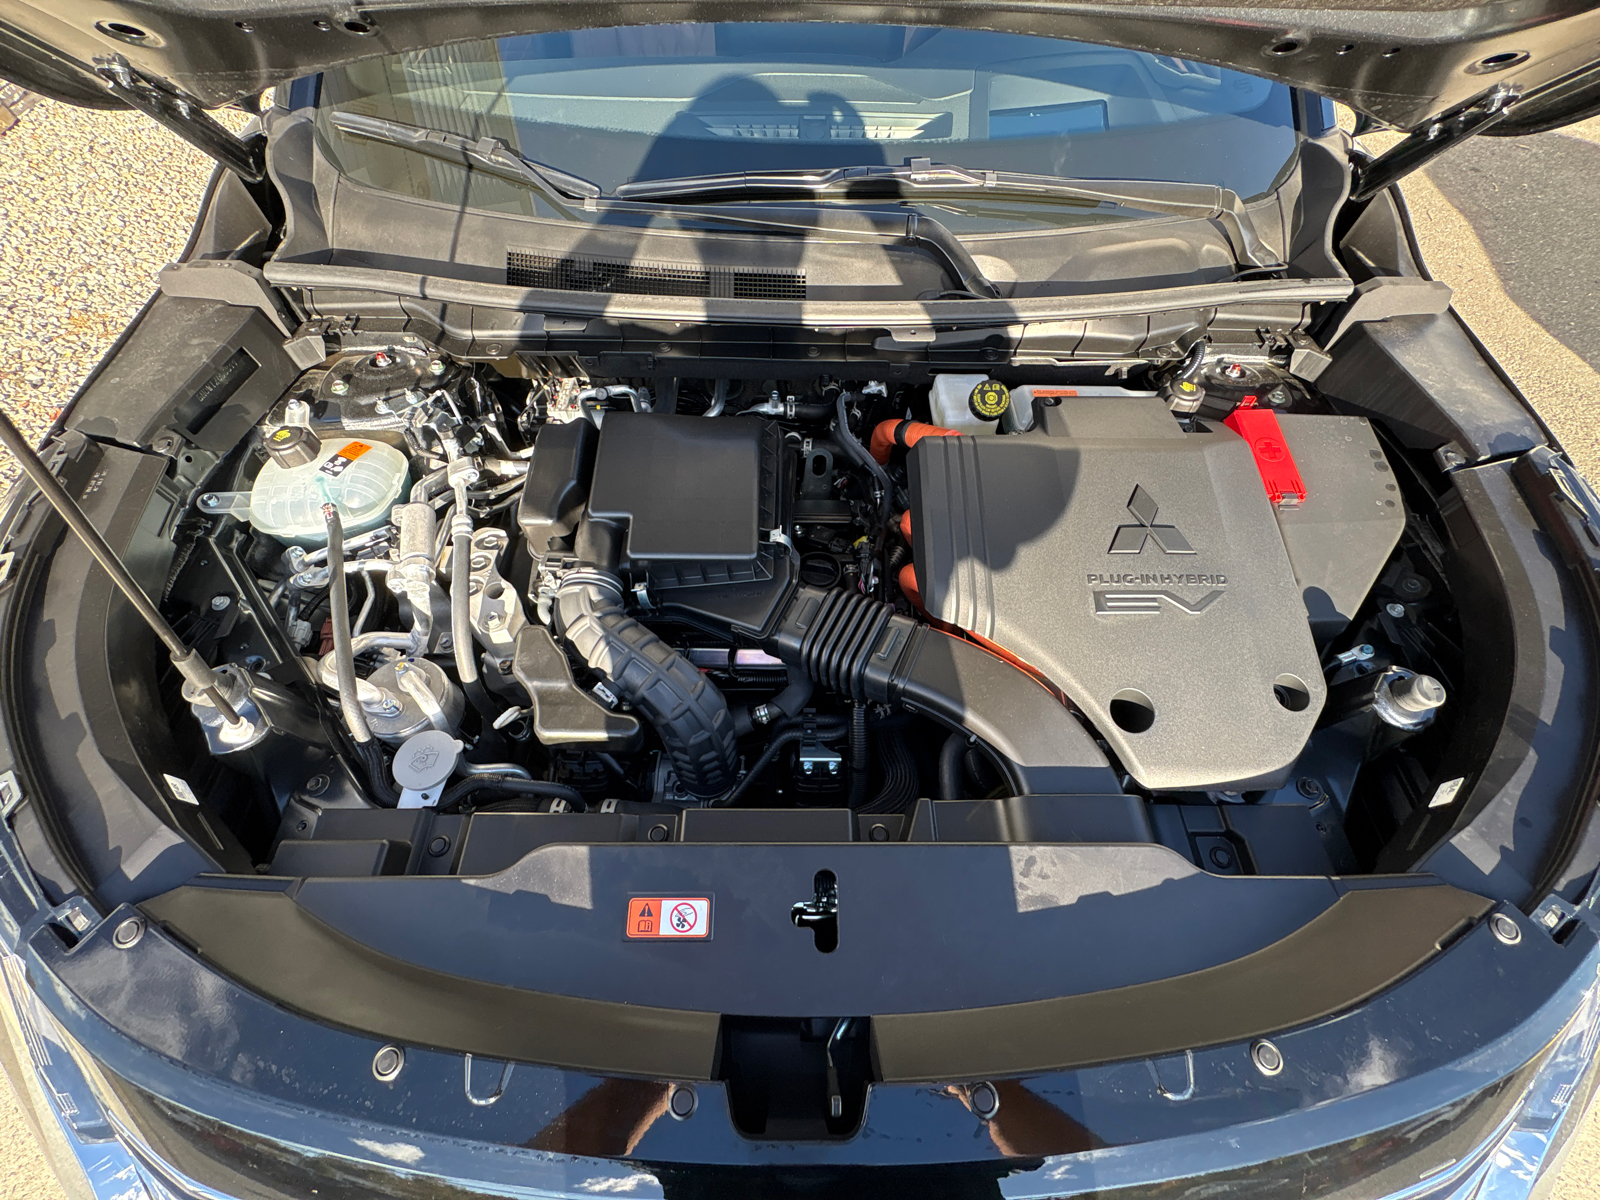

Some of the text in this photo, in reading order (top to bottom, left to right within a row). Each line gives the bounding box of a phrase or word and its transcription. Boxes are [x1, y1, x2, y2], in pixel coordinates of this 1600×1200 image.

[1086, 574, 1228, 586] PLUG-IN HYBRID
[1093, 590, 1226, 614] EV
